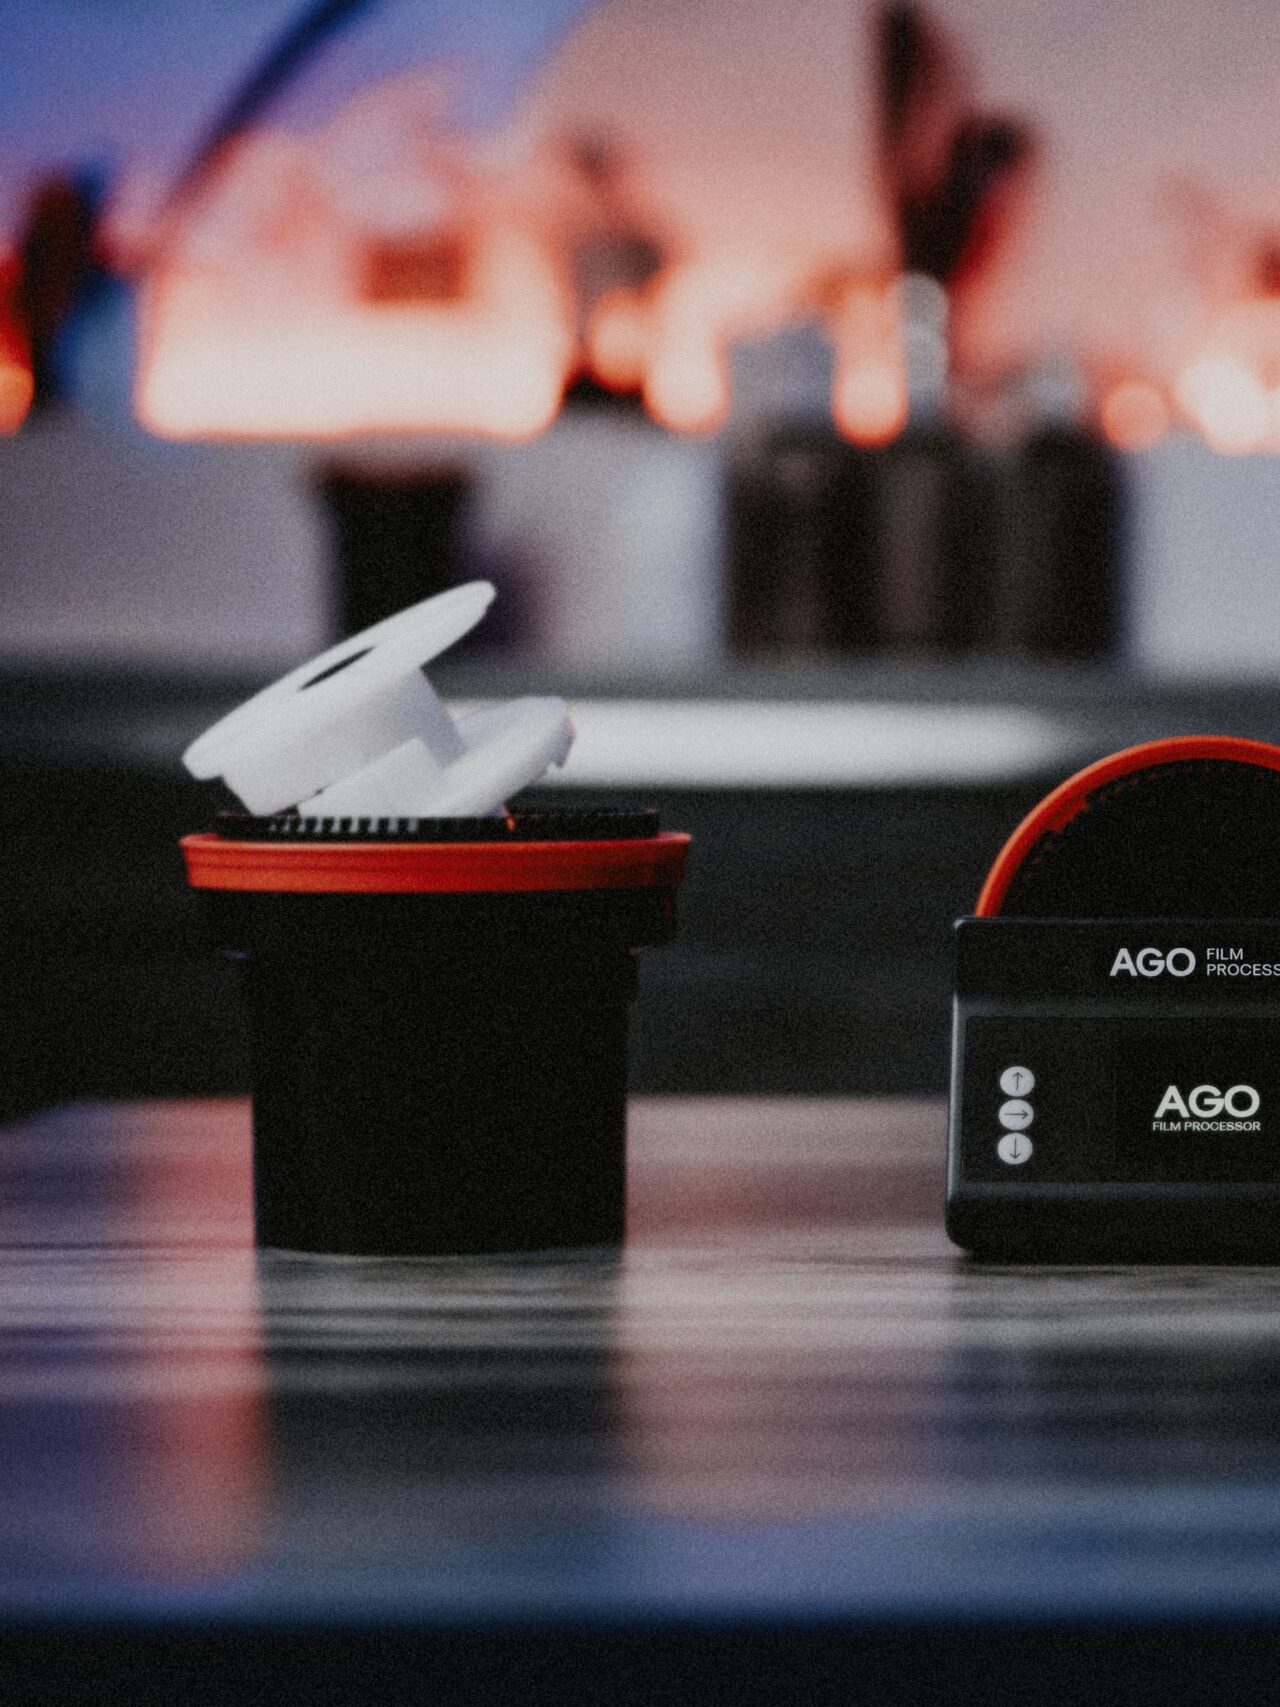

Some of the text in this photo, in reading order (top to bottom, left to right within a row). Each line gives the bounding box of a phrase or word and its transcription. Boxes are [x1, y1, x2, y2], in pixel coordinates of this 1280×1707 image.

[1109, 947, 1197, 977] AGO
[1206, 947, 1244, 960] FILM
[1153, 1084, 1260, 1118] AGO
[1152, 1121, 1261, 1131] FILM PROCESSOR
